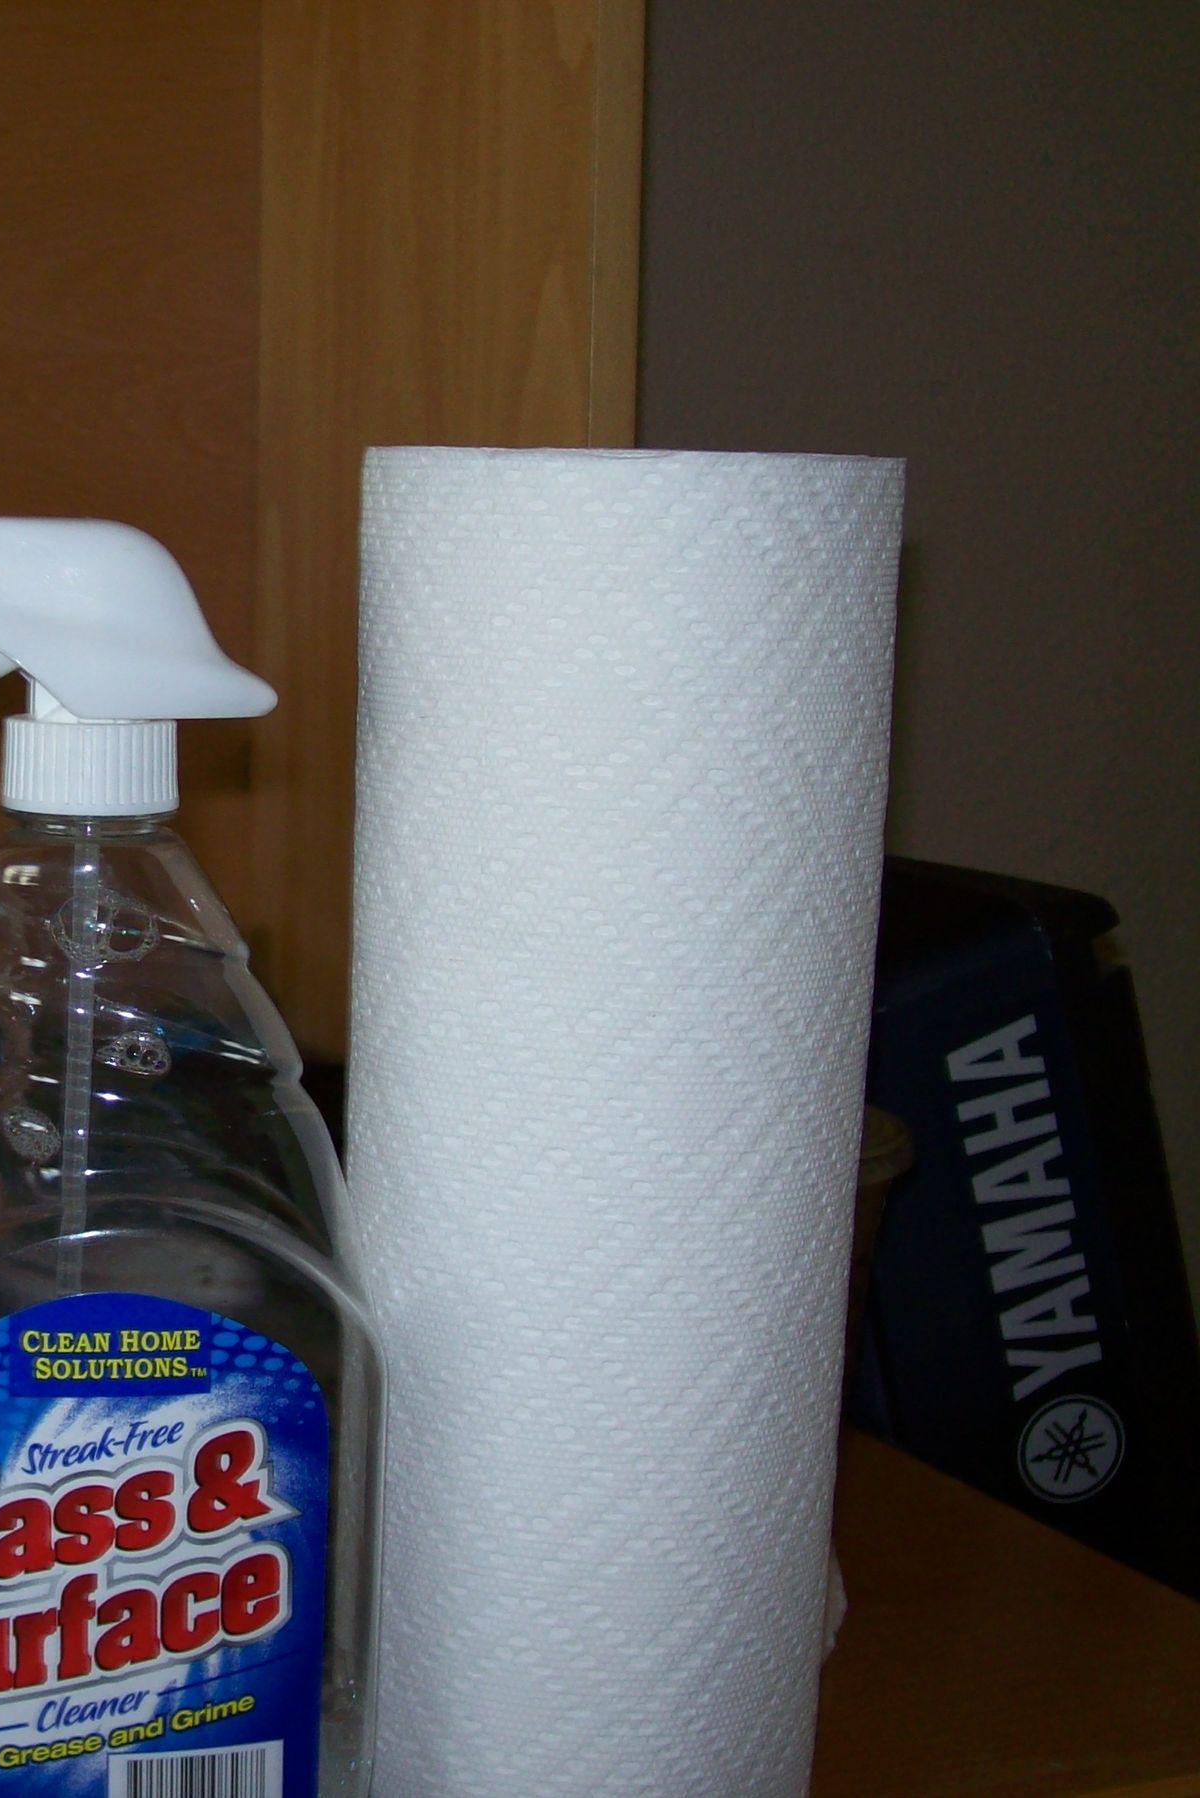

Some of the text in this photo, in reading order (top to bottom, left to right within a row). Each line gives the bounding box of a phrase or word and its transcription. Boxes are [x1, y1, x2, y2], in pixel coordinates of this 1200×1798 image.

[946, 1013, 1102, 1401] YAMAHA
[22, 1329, 201, 1353] CLEAN HOME
[35, 1356, 189, 1381] SOLUTIONS
[22, 1420, 185, 1475] Streak-Free
[187, 1429, 272, 1533] &
[36, 1689, 152, 1733] Cleaner
[108, 1720, 163, 1747] and
[170, 1695, 255, 1732] Grime
